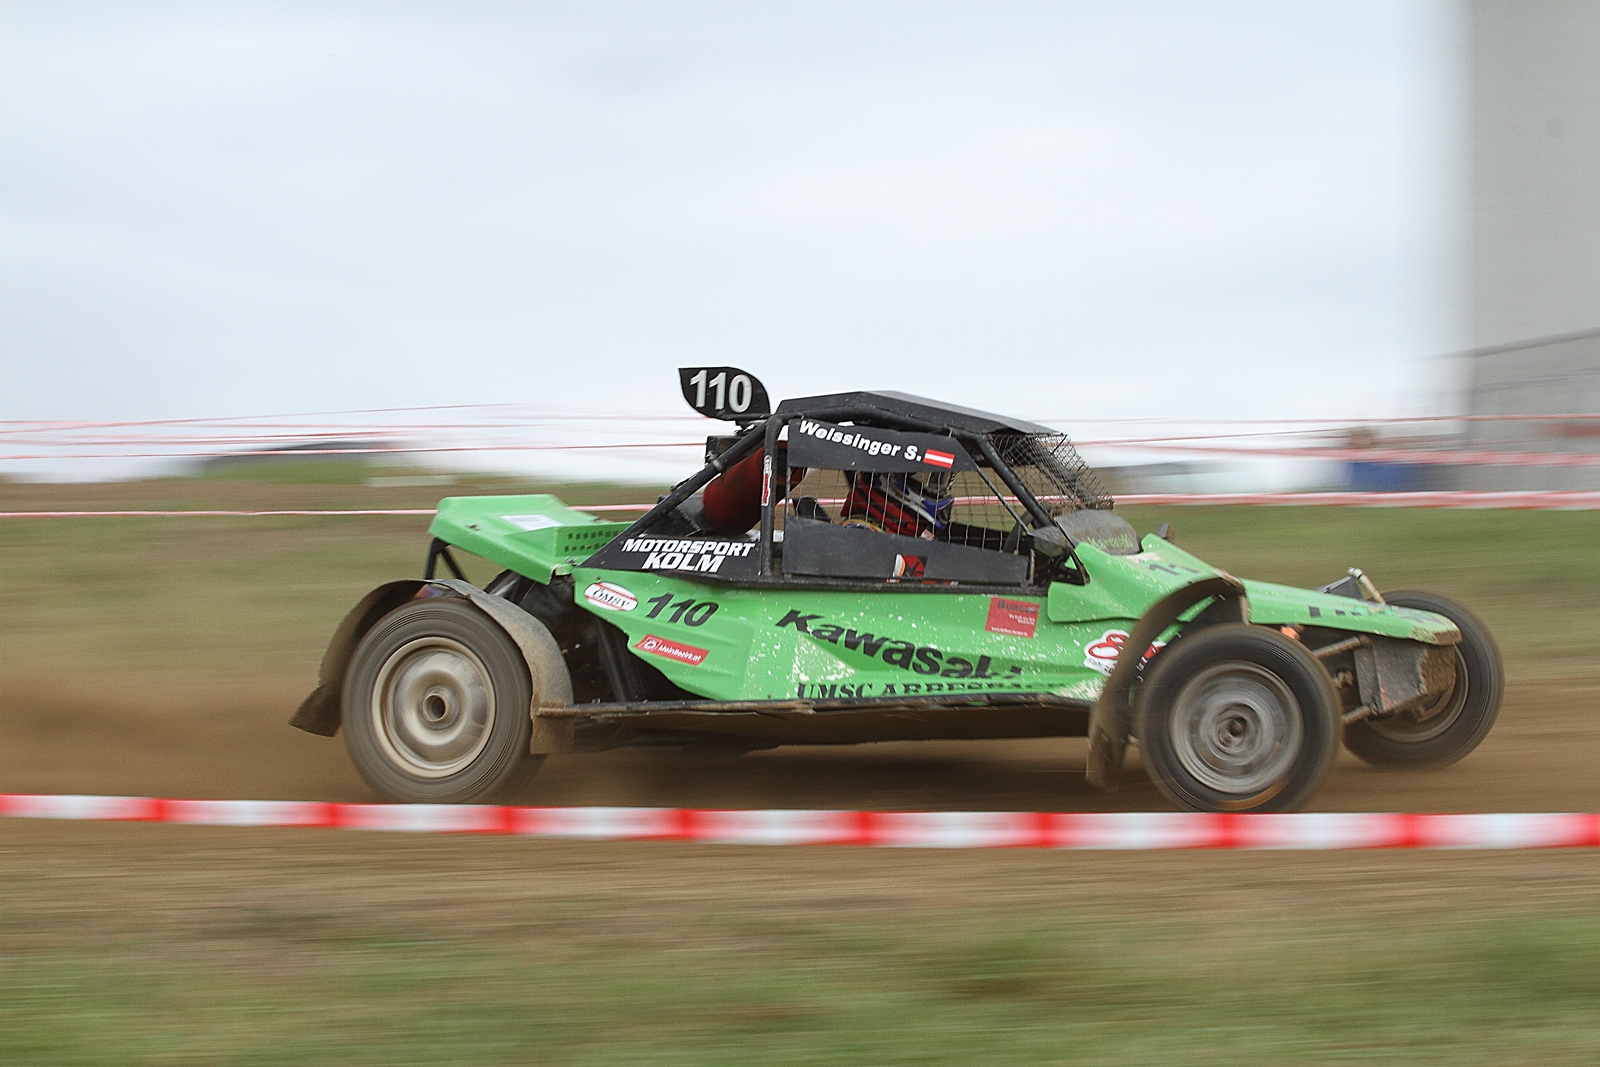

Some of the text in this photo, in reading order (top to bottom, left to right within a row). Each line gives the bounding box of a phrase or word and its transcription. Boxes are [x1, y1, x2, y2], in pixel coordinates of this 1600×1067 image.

[689, 369, 752, 413] 110
[799, 419, 922, 462] Weissinger S.
[621, 538, 756, 557] MOTORSPORT
[641, 552, 726, 573] KOLM
[645, 592, 719, 627] 110
[797, 682, 873, 699] UMSC
